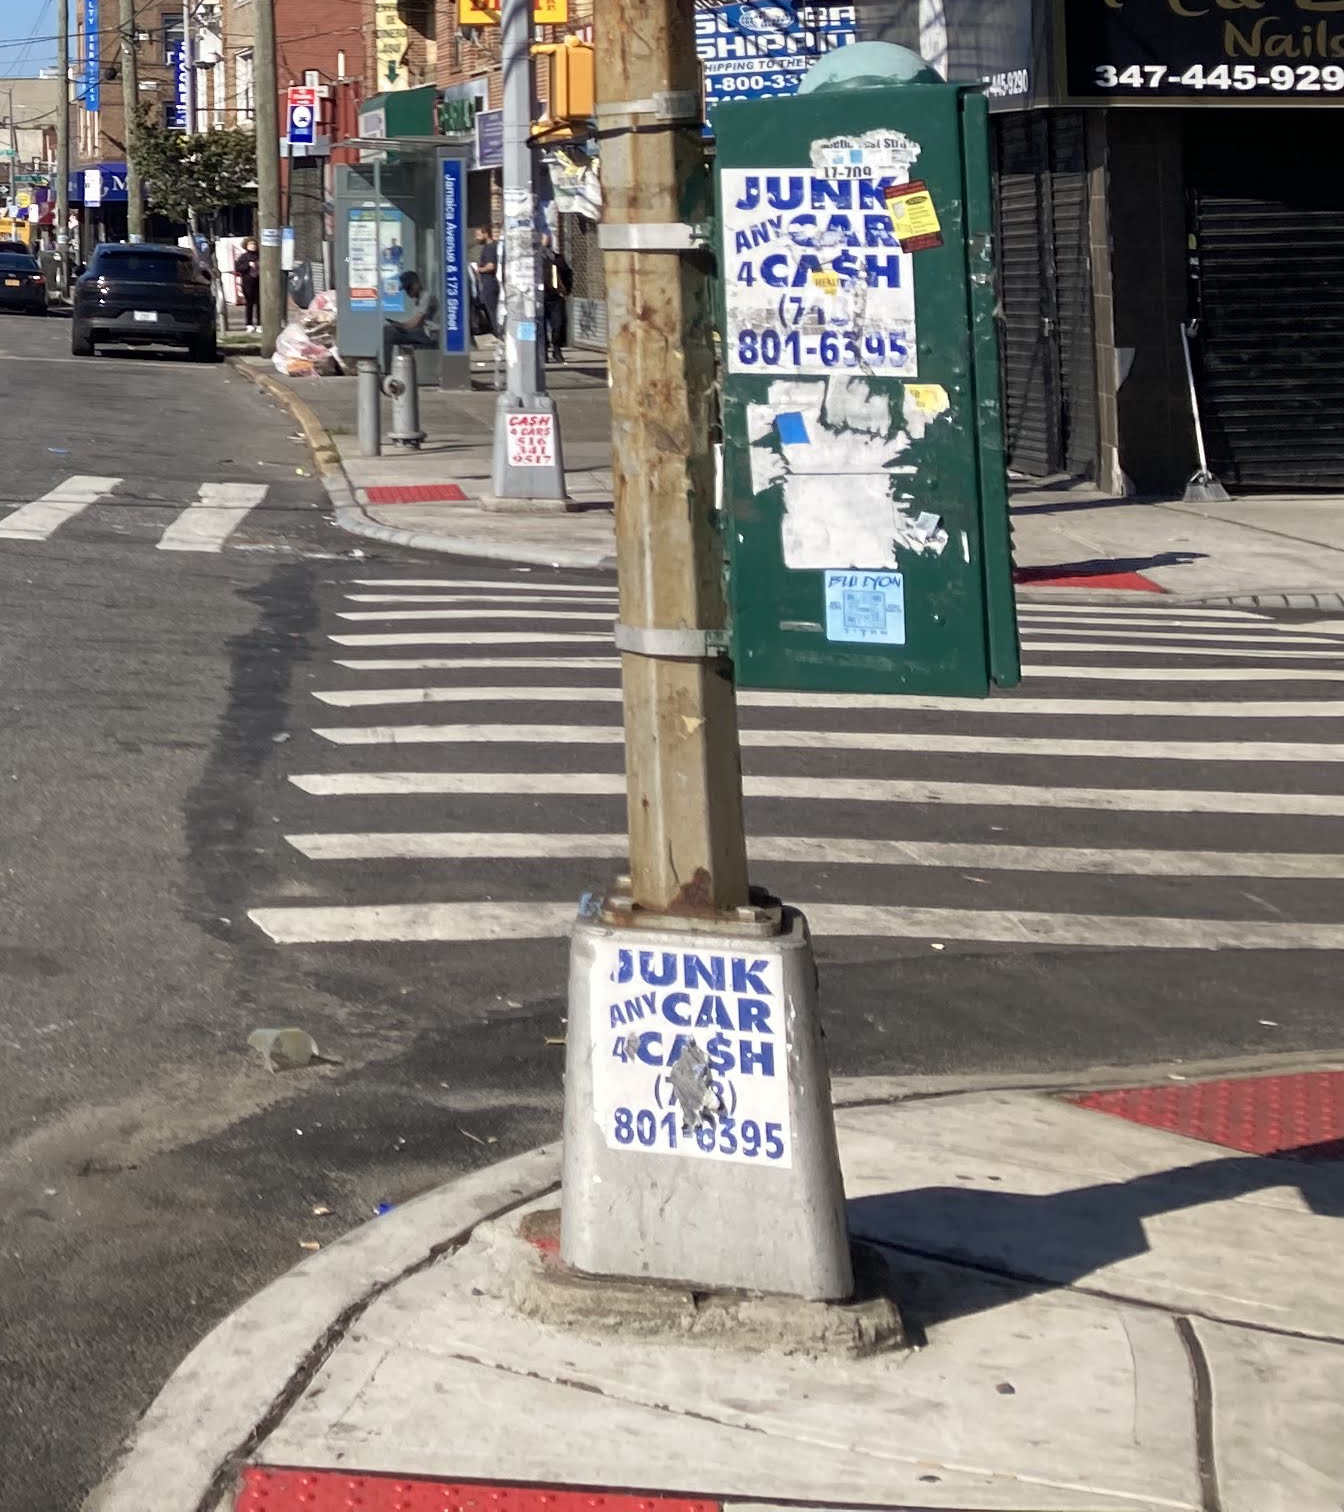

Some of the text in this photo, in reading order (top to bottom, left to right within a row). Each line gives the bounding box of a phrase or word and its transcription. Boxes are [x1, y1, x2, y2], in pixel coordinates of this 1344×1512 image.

[696, 28, 856, 60] SHIPPIN
[1224, 16, 1344, 58] Nails
[443, 172, 458, 220] Jamaica
[734, 175, 899, 211] JUNK
[445, 221, 459, 263] Avenue
[734, 214, 784, 254] ANY
[787, 213, 901, 248] CAR
[445, 274, 460, 295] 173
[737, 260, 757, 287] 4
[446, 296, 460, 331] Street
[737, 328, 909, 368] 801-6395
[508, 416, 552, 427] CASH
[520, 427, 551, 437] CARS
[609, 948, 775, 997] JUNK
[609, 991, 775, 1036] ANY CAR
[611, 1035, 628, 1064] 4
[654, 1073, 738, 1117] (78)
